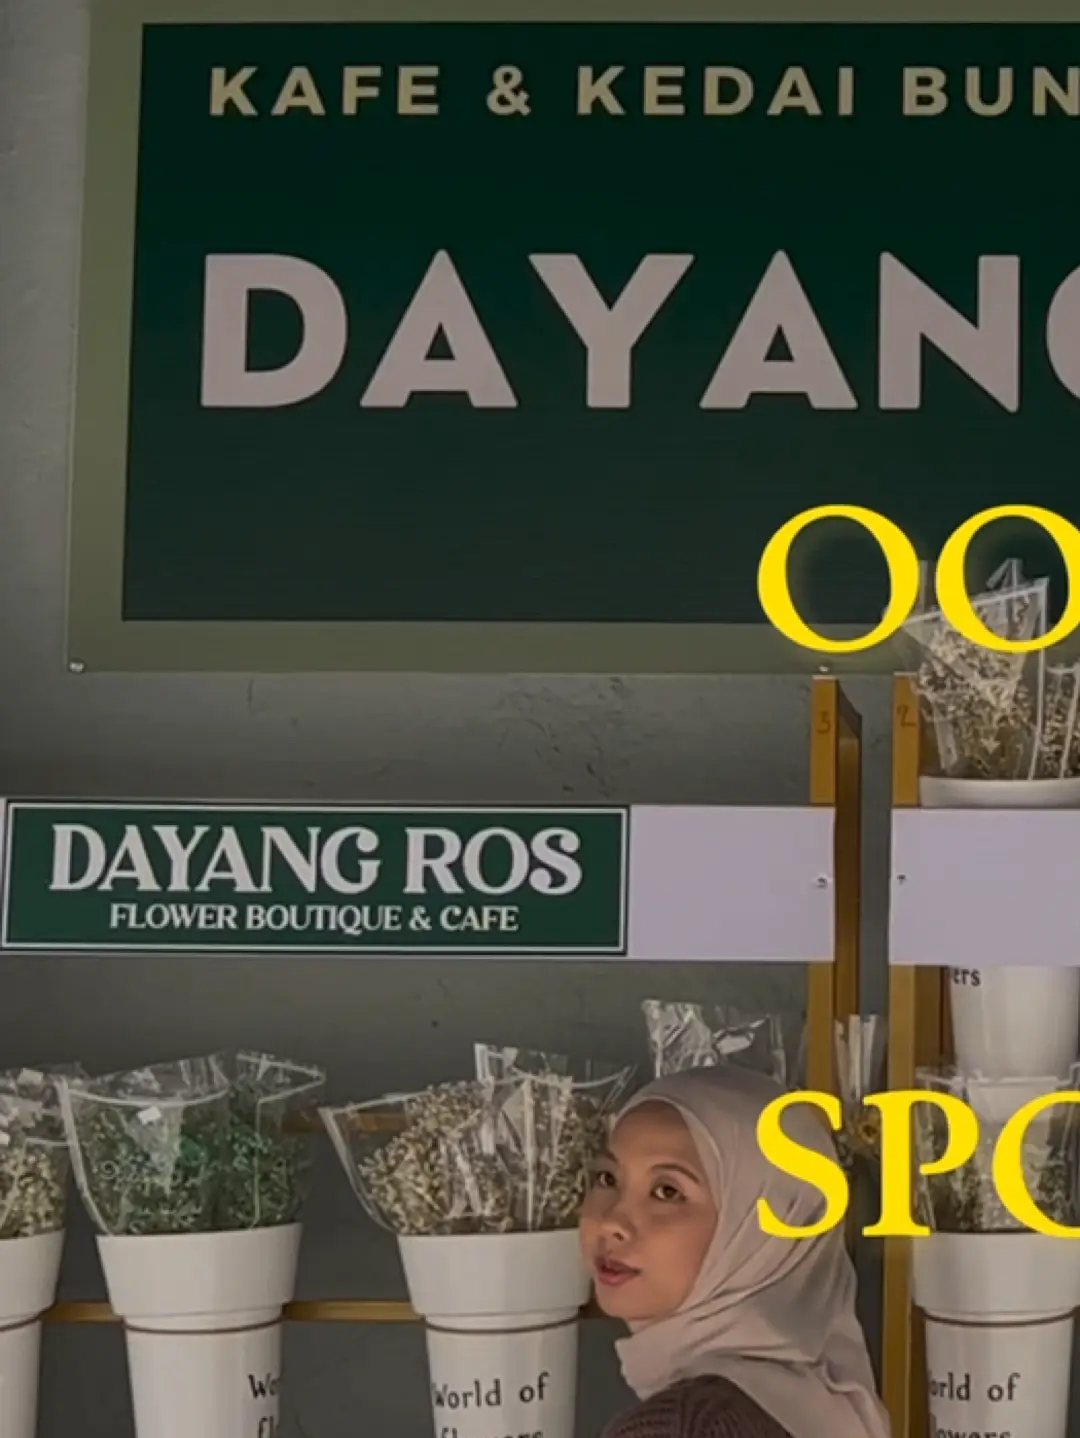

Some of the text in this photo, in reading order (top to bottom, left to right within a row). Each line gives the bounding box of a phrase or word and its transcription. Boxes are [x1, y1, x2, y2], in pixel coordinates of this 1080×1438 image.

[209, 66, 440, 116] KAFE
[487, 66, 531, 116] &
[577, 66, 855, 116] KEDAI
[48, 823, 583, 896] DAYANG ROS
[109, 903, 519, 937] FLOWER BOUTIQUE & CAFE
[518, 1371, 549, 1402] of
[987, 1372, 1021, 1402] of
